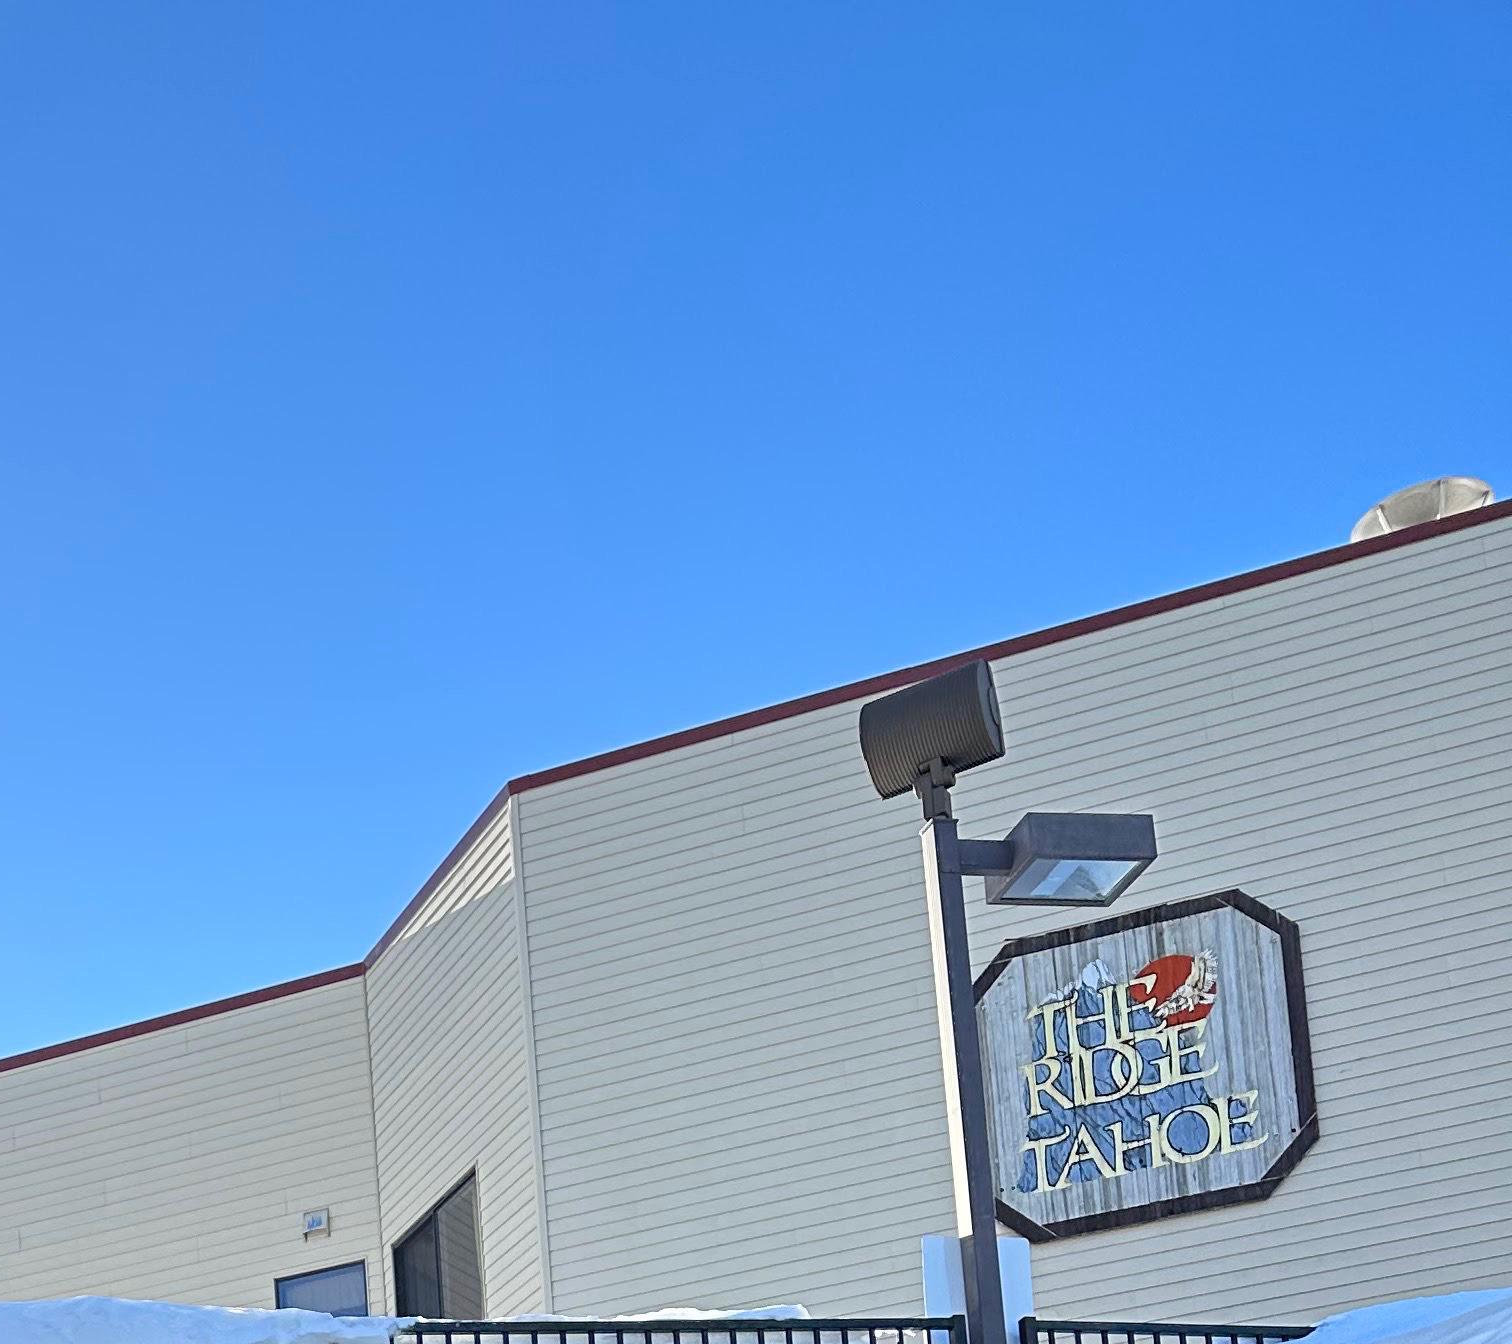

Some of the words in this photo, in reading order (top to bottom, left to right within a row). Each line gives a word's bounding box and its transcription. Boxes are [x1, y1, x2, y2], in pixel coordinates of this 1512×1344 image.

[1021, 1018, 1219, 1118] RIDGE
[1025, 975, 1167, 1061] THE
[1019, 1089, 1269, 1193] TAHOE
